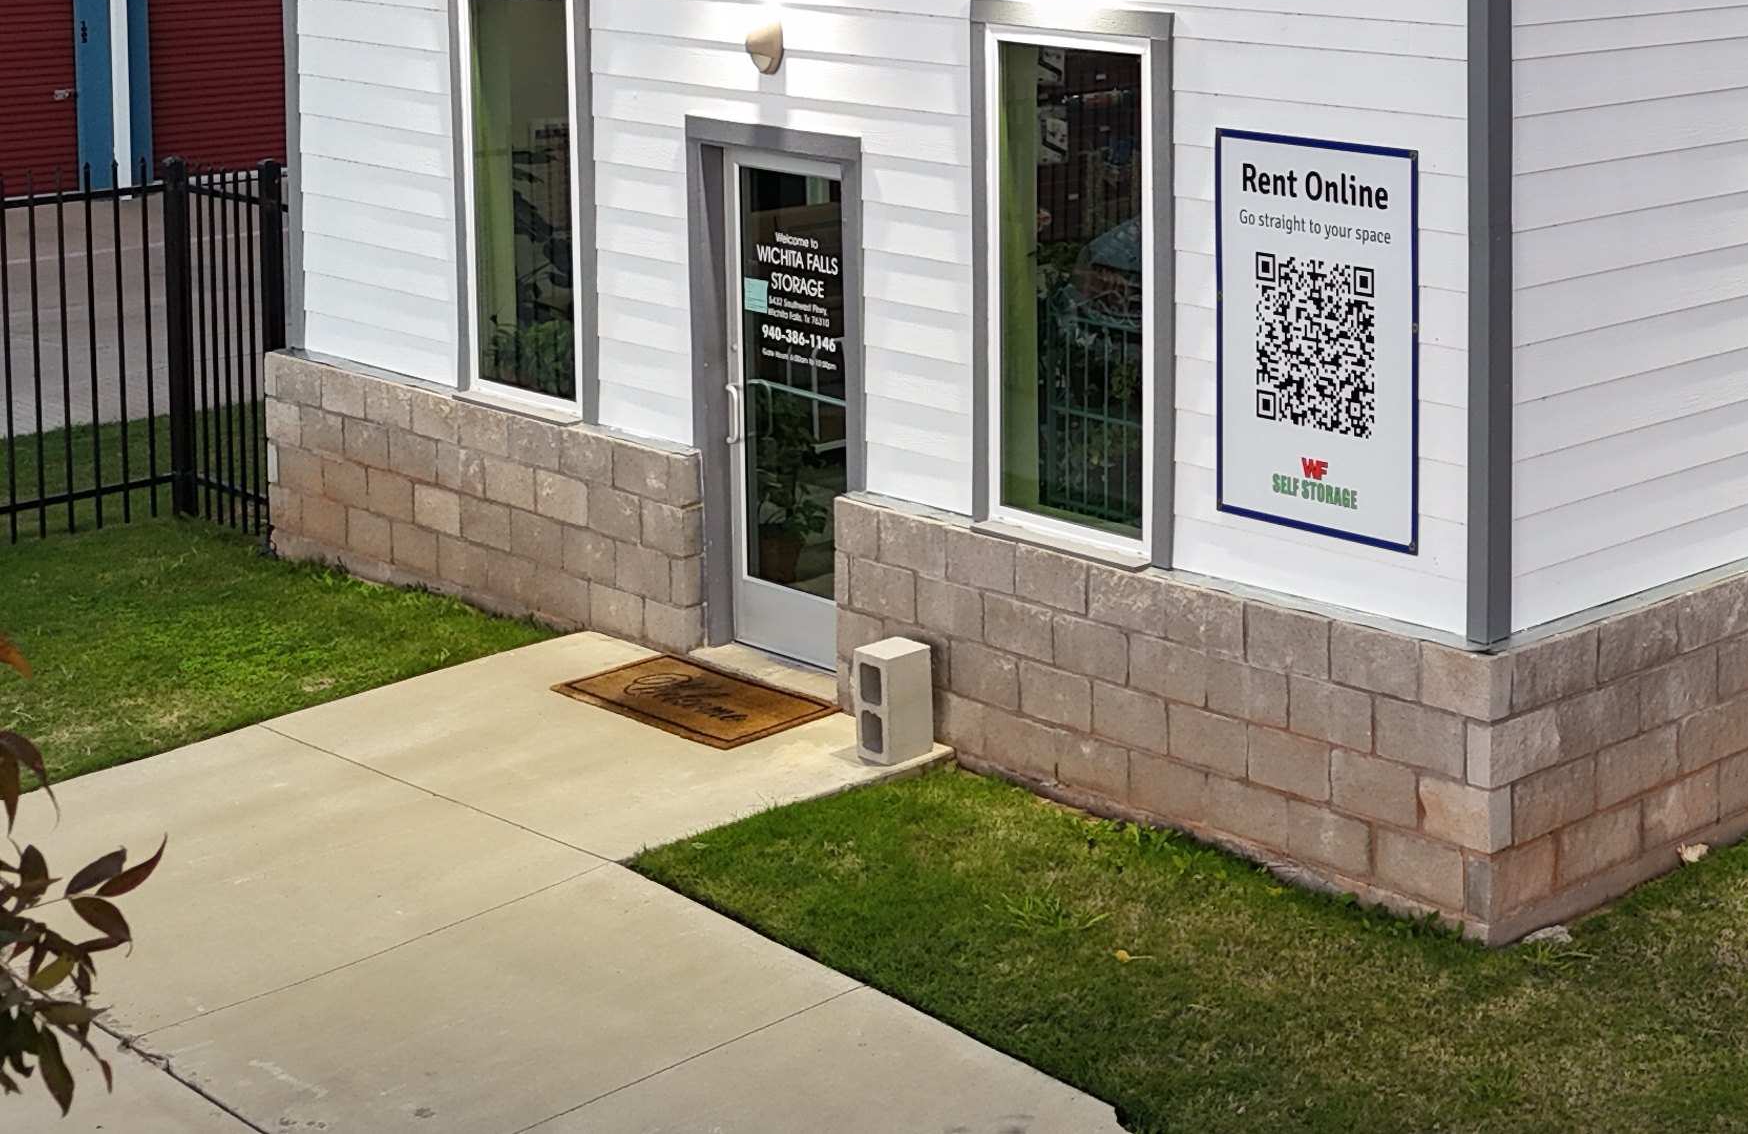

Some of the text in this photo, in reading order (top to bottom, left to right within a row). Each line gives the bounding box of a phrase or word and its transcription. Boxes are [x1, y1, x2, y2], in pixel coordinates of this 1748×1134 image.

[1242, 162, 1389, 210] Rent Online
[775, 232, 819, 250] Welcome to
[1239, 209, 1391, 245] Go straight to your space
[756, 244, 838, 275] WICHITA FALLS
[771, 271, 825, 299] STORAGE
[811, 316, 830, 327] 76310
[762, 324, 836, 352] 940-386-1146
[1301, 457, 1329, 481] WF
[1272, 473, 1358, 510] SELF STORAGE
